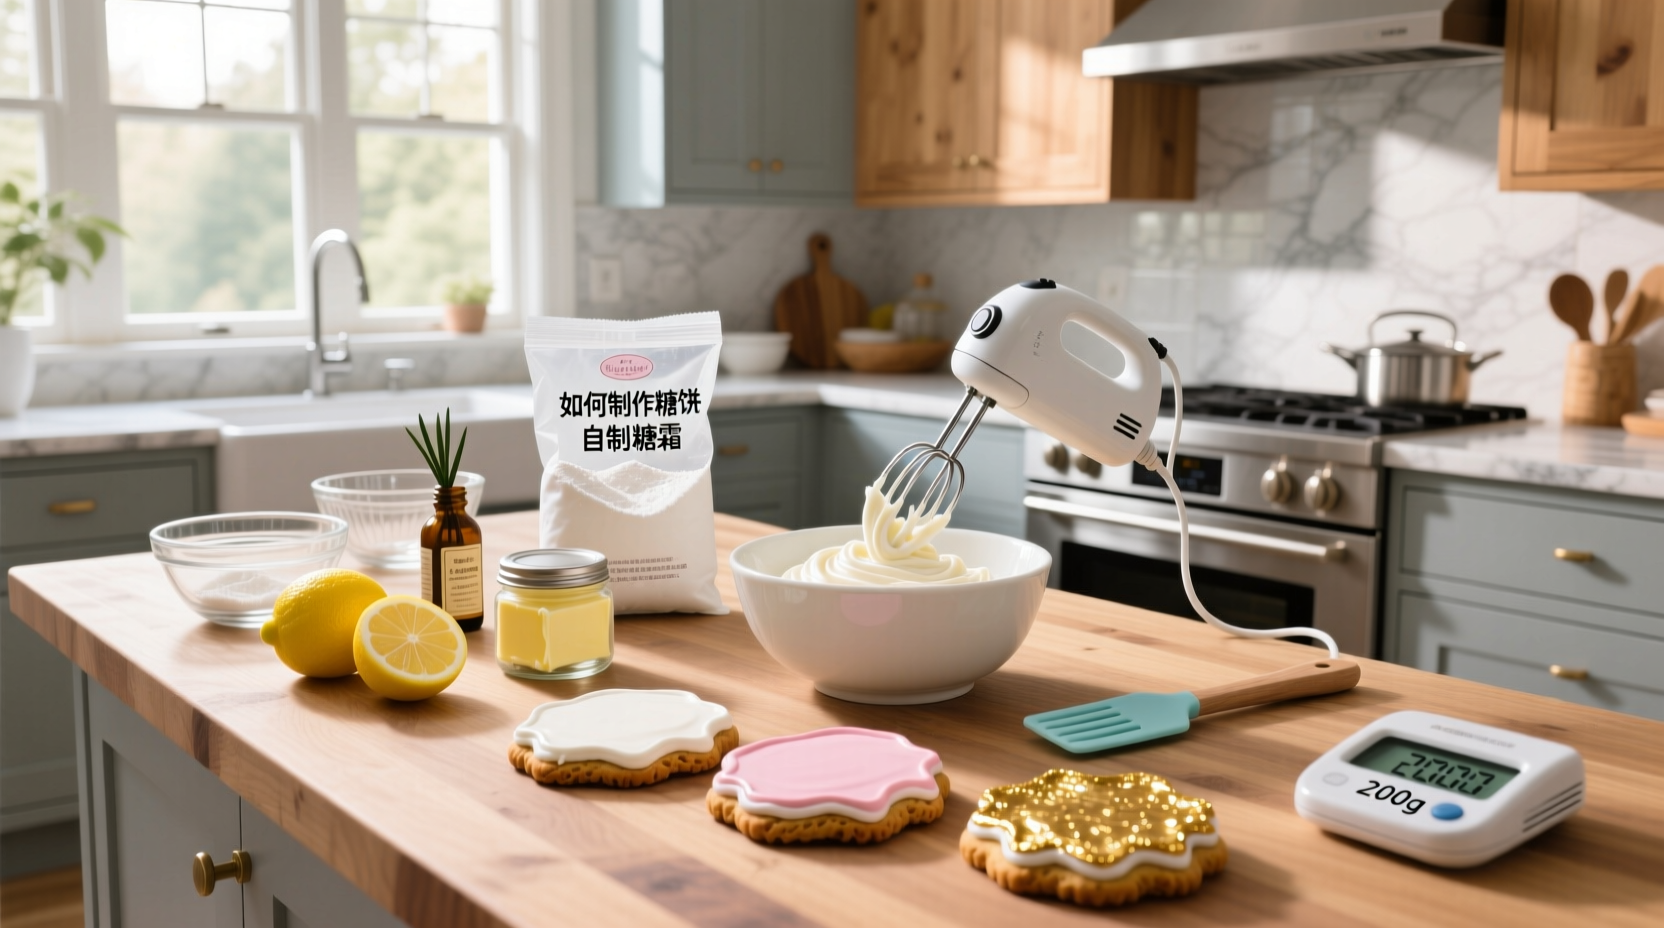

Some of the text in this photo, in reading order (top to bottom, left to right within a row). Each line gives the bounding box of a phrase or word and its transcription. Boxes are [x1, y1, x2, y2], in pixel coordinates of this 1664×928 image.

[559, 388, 701, 418] 如何制作糖饼
[583, 422, 682, 452] 自制糖霜
[1356, 780, 1426, 815] 200g
